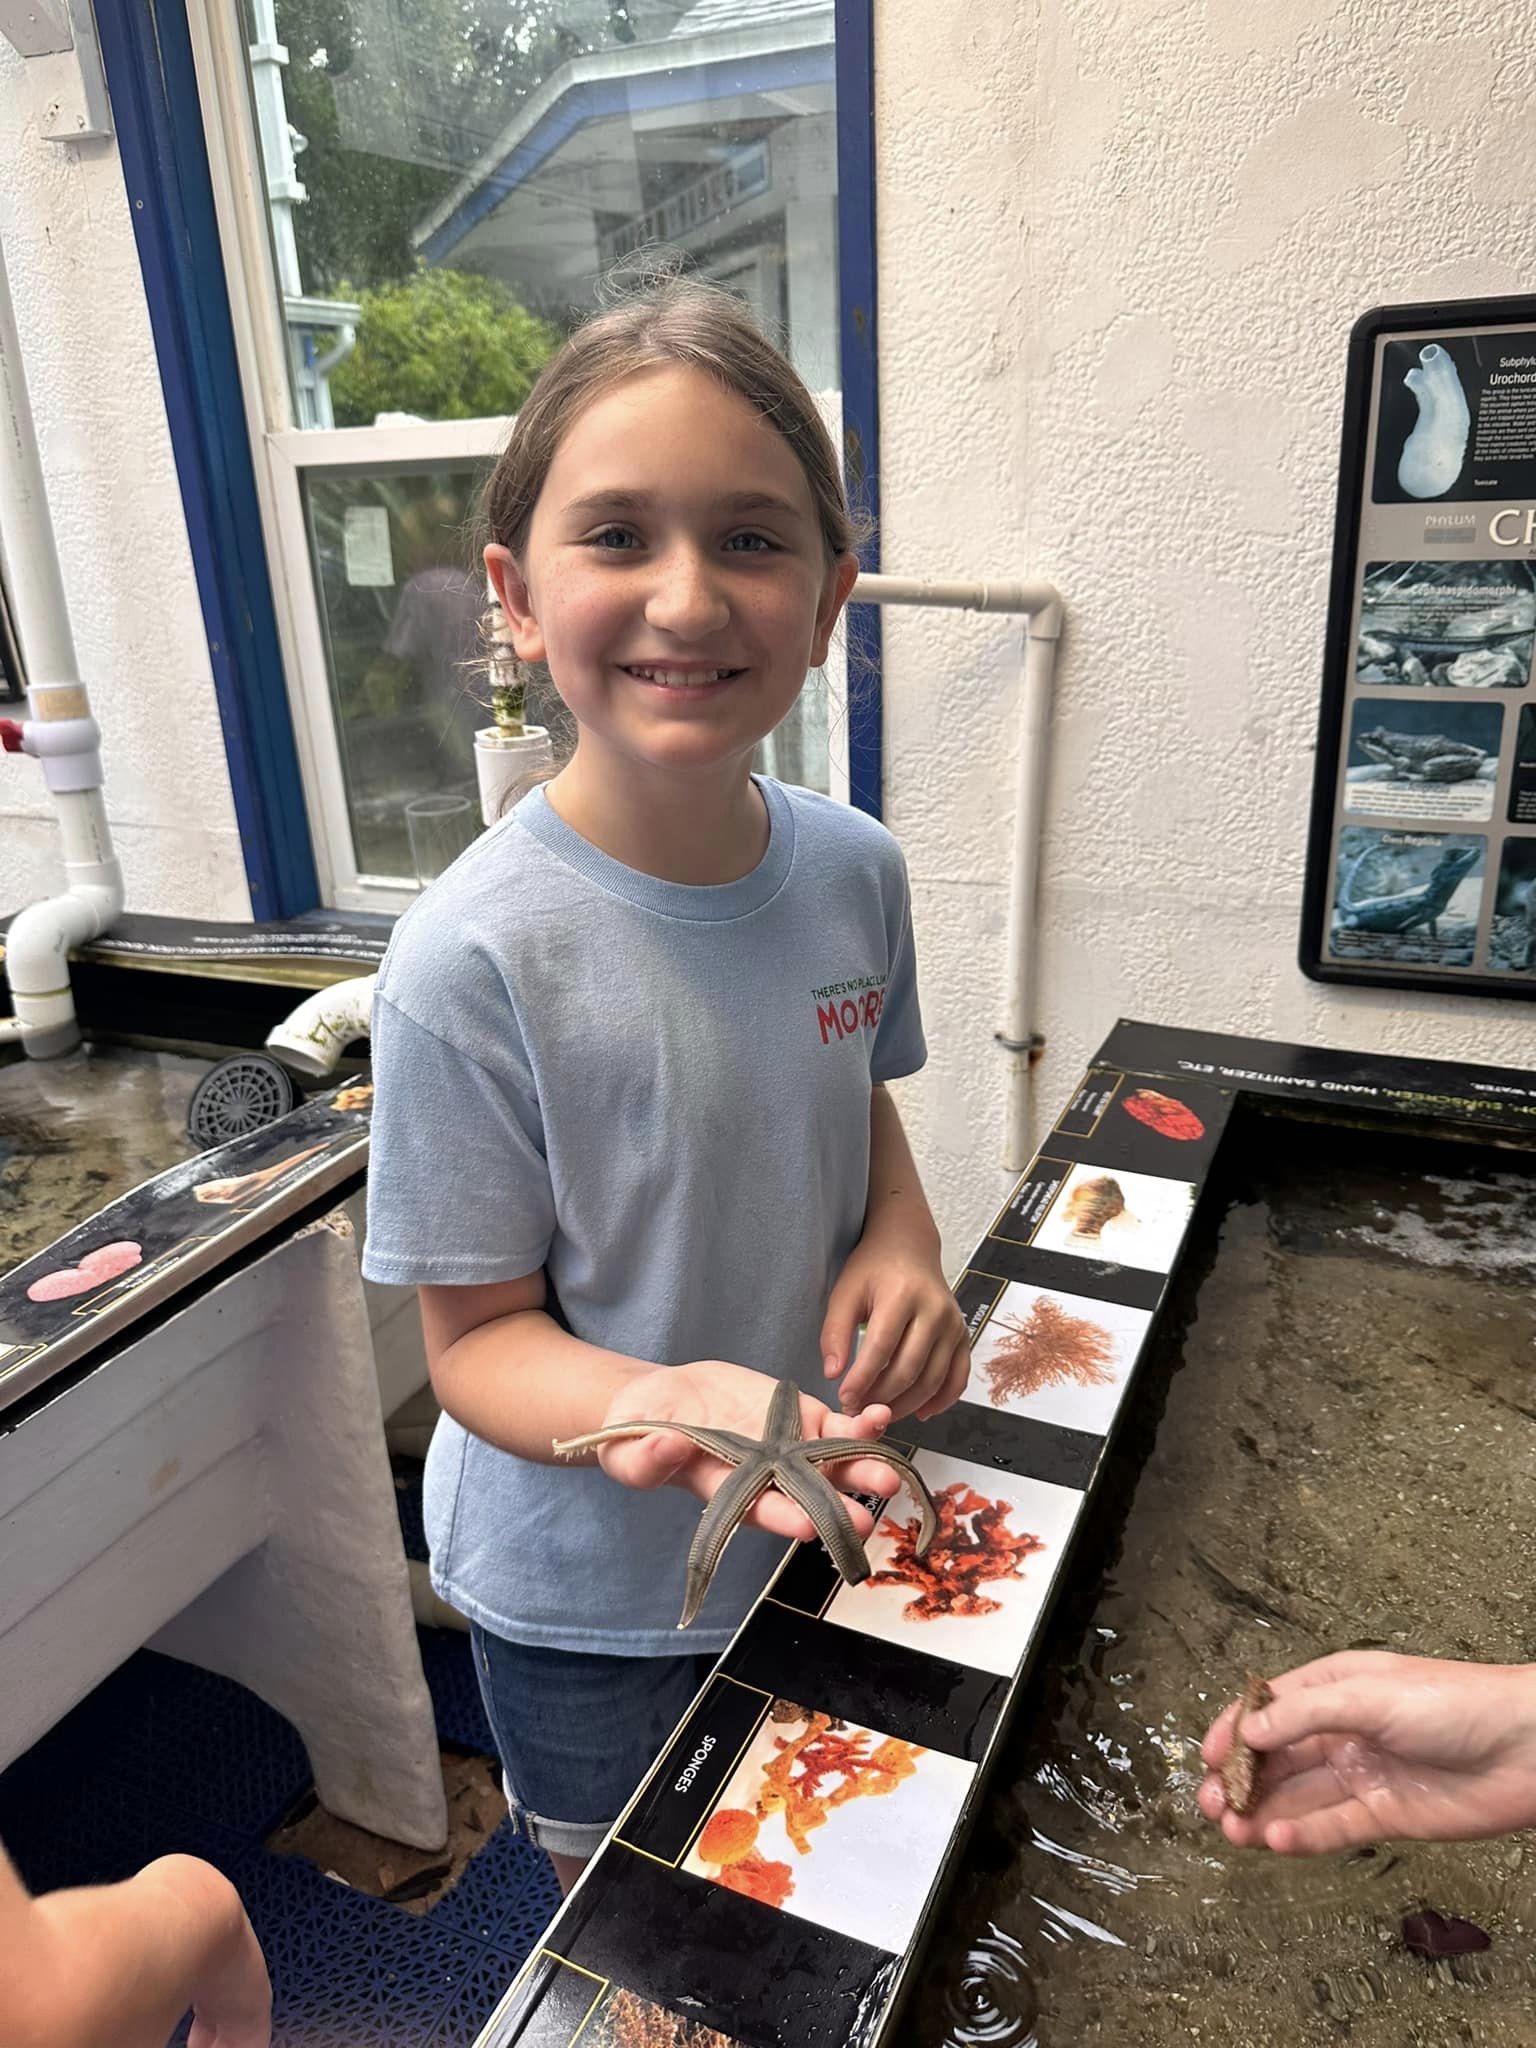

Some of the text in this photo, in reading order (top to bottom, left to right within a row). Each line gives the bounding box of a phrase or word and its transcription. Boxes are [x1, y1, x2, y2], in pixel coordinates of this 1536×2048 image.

[810, 982, 847, 1000] THERE'S
[1177, 1060, 1216, 1074] ETC.
[1218, 1065, 1318, 1088] SANITIZER,
[1320, 1080, 1378, 1097] HAND
[674, 1734, 717, 1793] SPONGES
